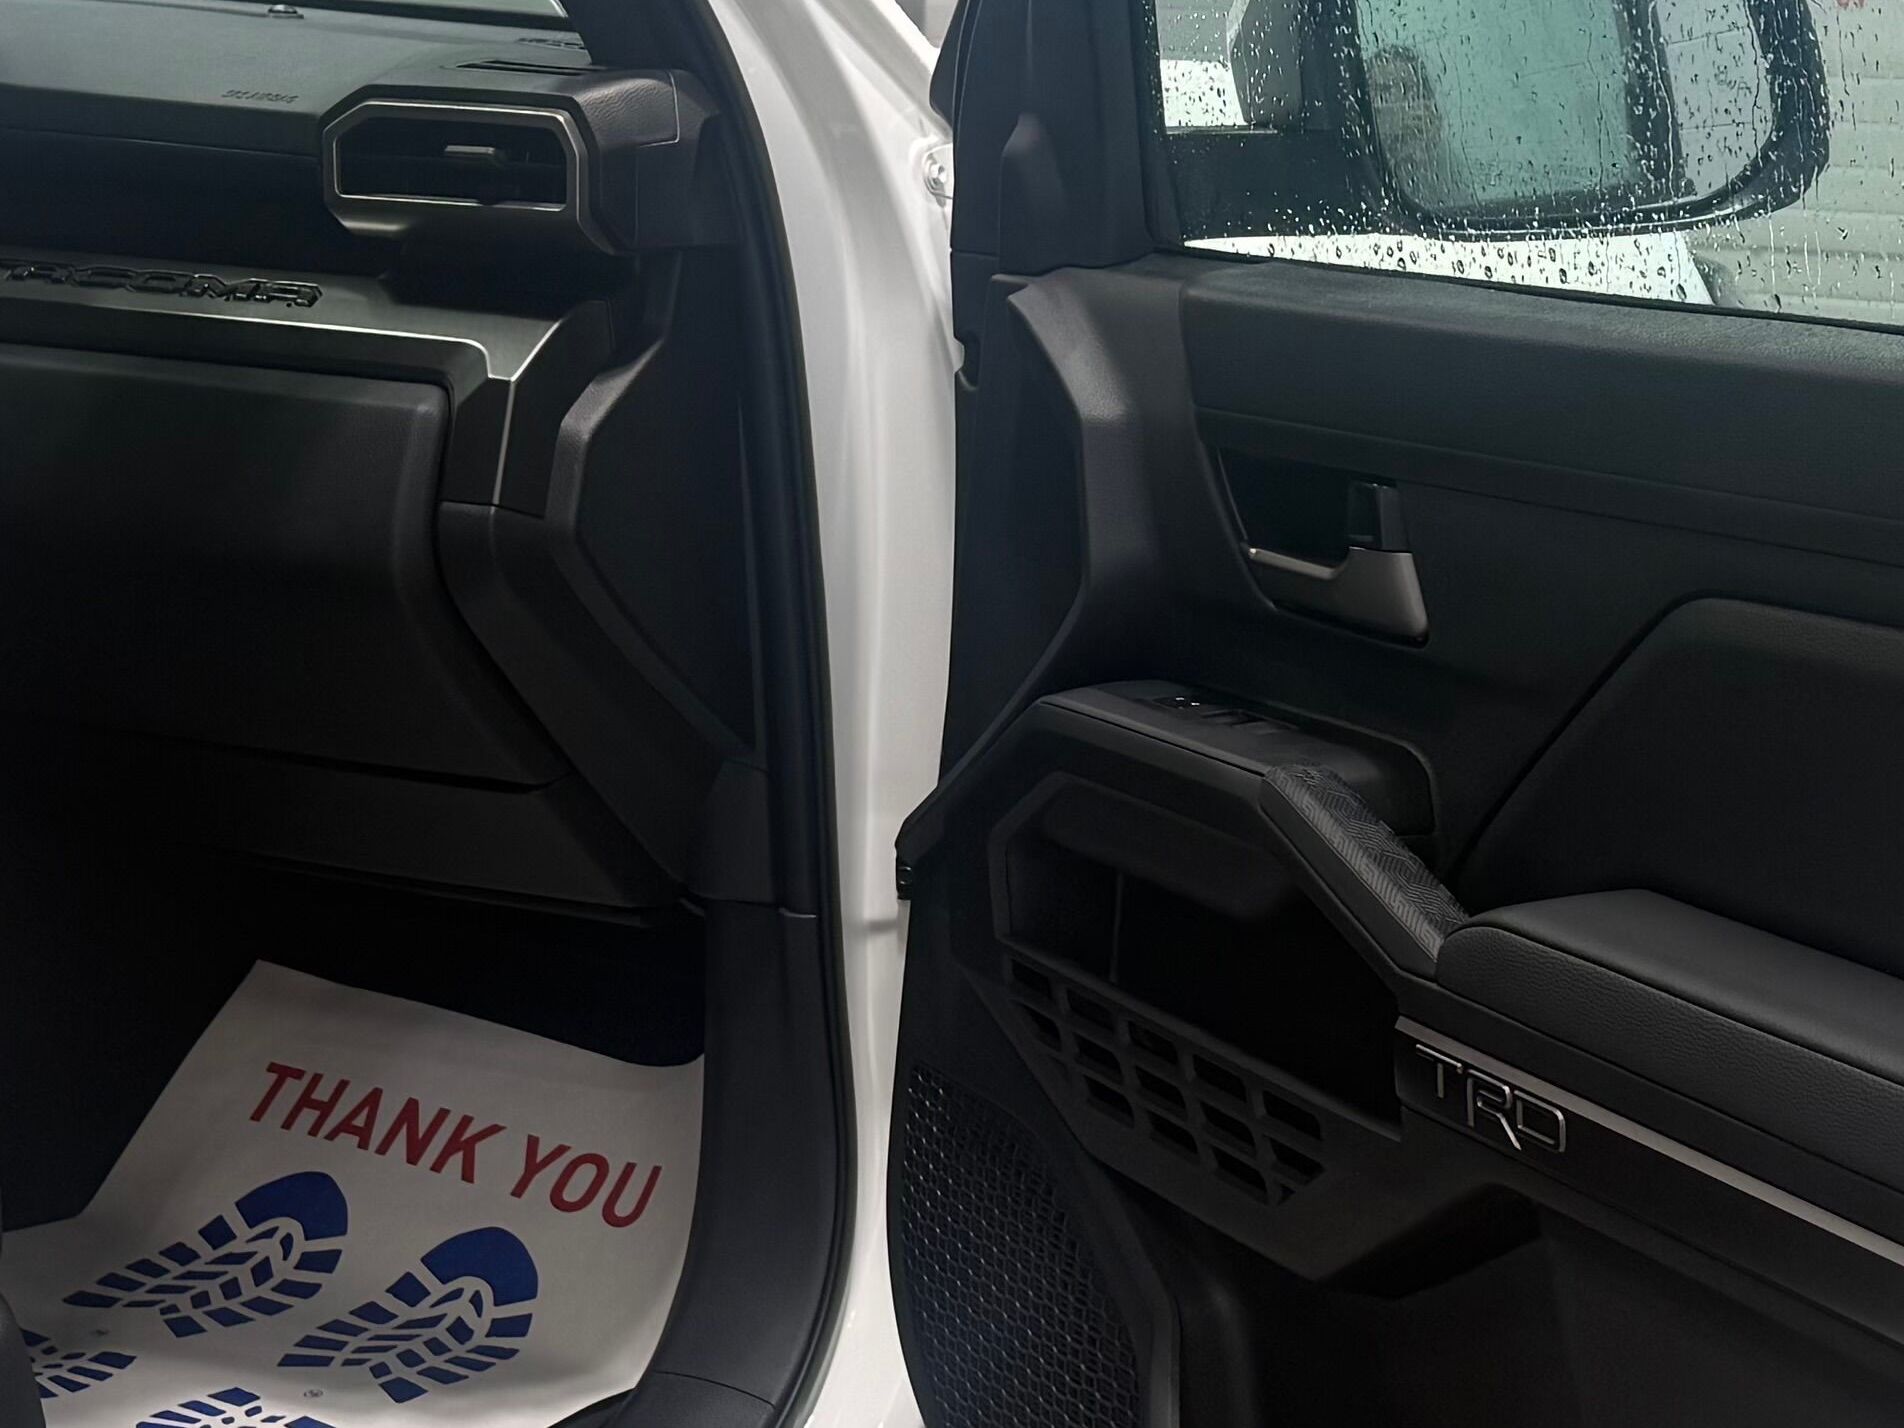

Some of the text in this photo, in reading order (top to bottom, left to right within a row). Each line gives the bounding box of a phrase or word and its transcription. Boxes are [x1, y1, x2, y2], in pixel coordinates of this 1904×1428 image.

[249, 1062, 663, 1228] THANK YOU
[1415, 1043, 1566, 1152] TRD
